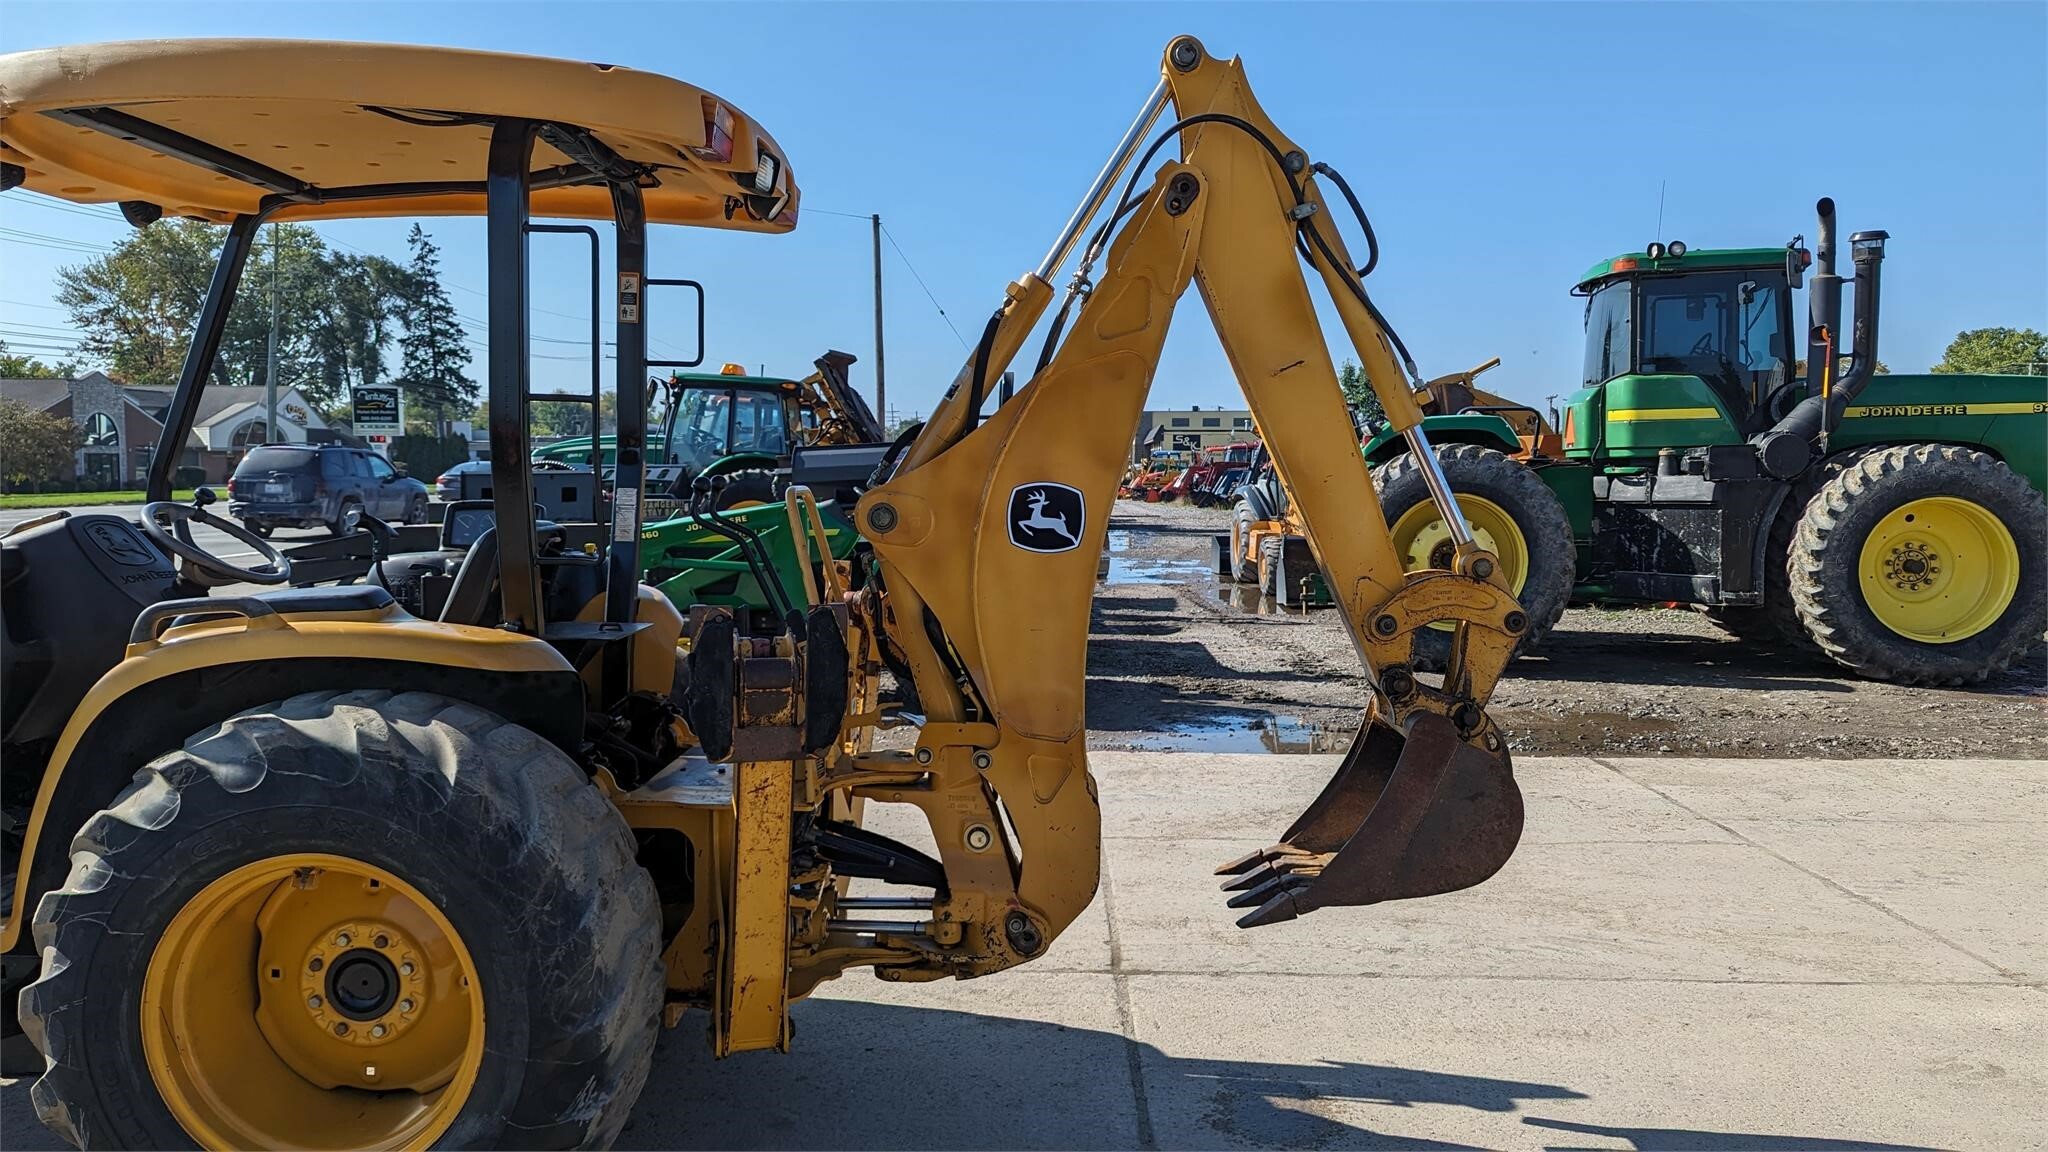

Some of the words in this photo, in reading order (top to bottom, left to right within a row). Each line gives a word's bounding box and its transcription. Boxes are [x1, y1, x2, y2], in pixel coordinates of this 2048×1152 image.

[1860, 406, 1905, 417] JOHN
[1911, 405, 1964, 416] DEERE
[1173, 435, 1201, 451] S&K
[120, 572, 152, 585] JOHN
